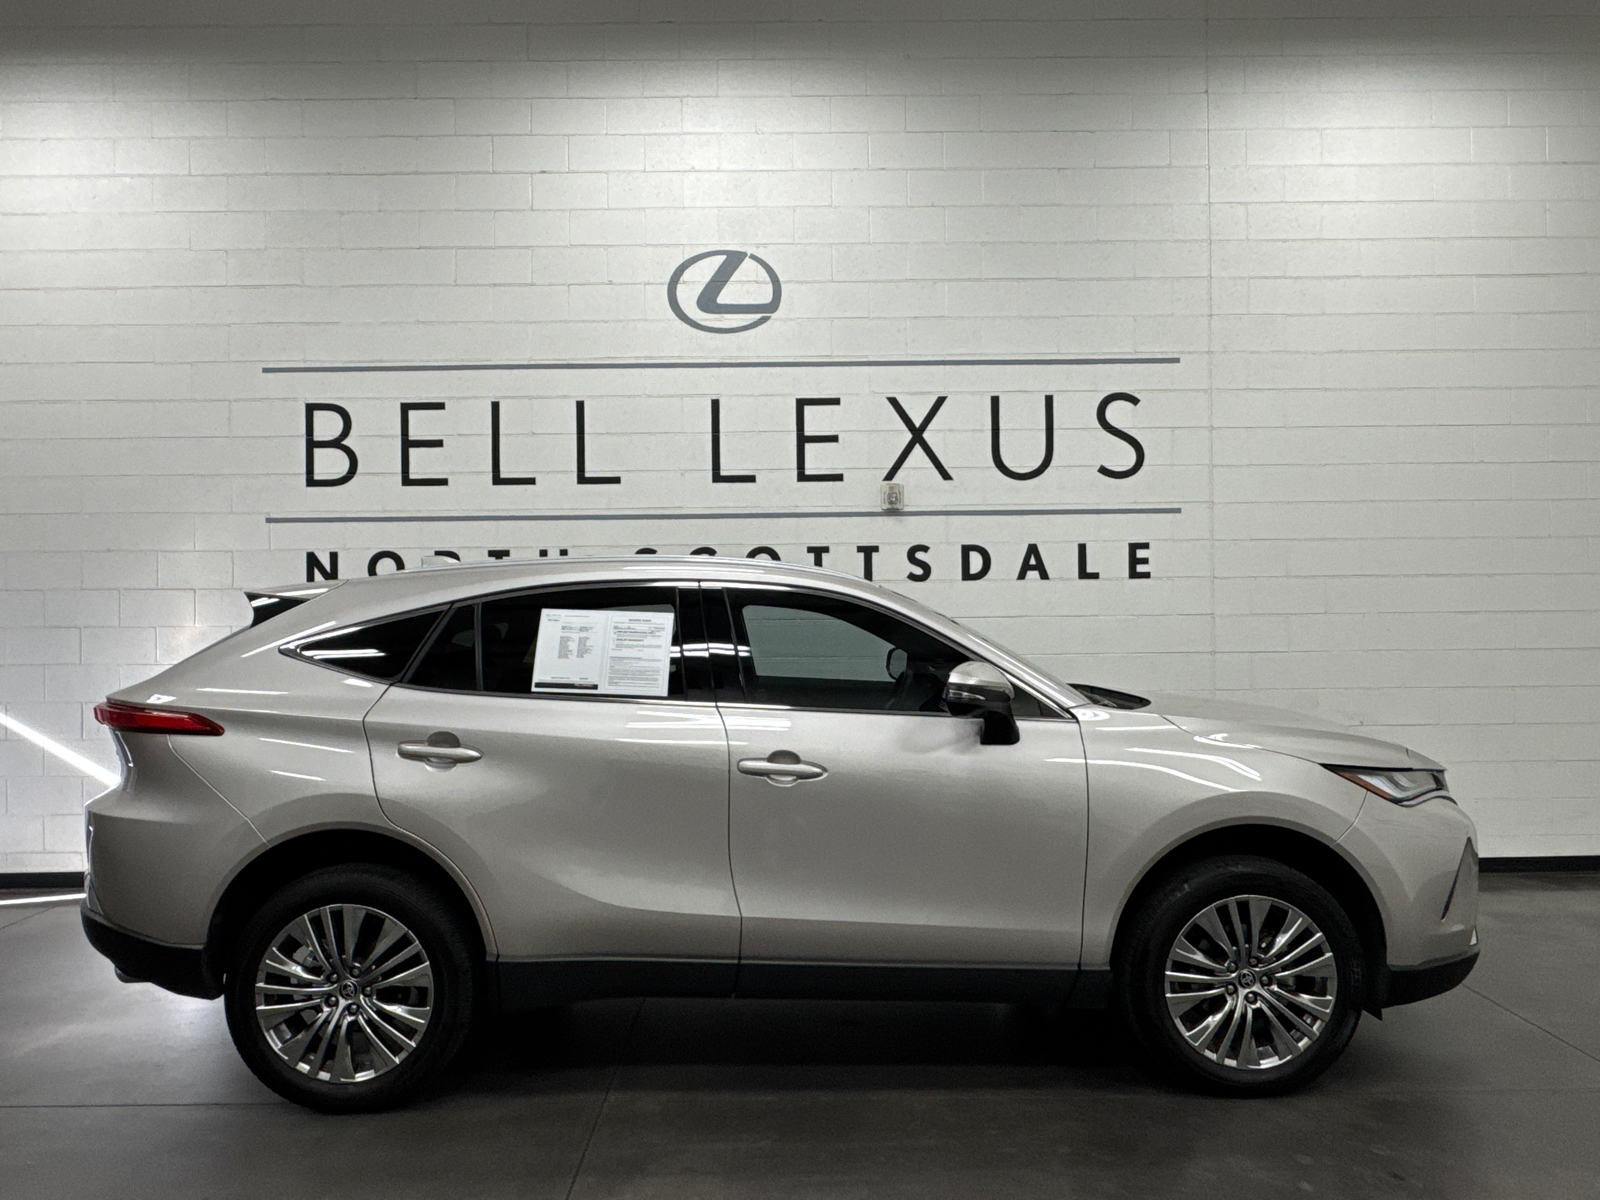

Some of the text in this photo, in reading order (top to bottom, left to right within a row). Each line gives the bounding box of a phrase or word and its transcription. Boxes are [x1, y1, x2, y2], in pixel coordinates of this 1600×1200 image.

[305, 391, 1145, 488] BELL LEXUS
[634, 542, 1152, 583] TTSDALE
